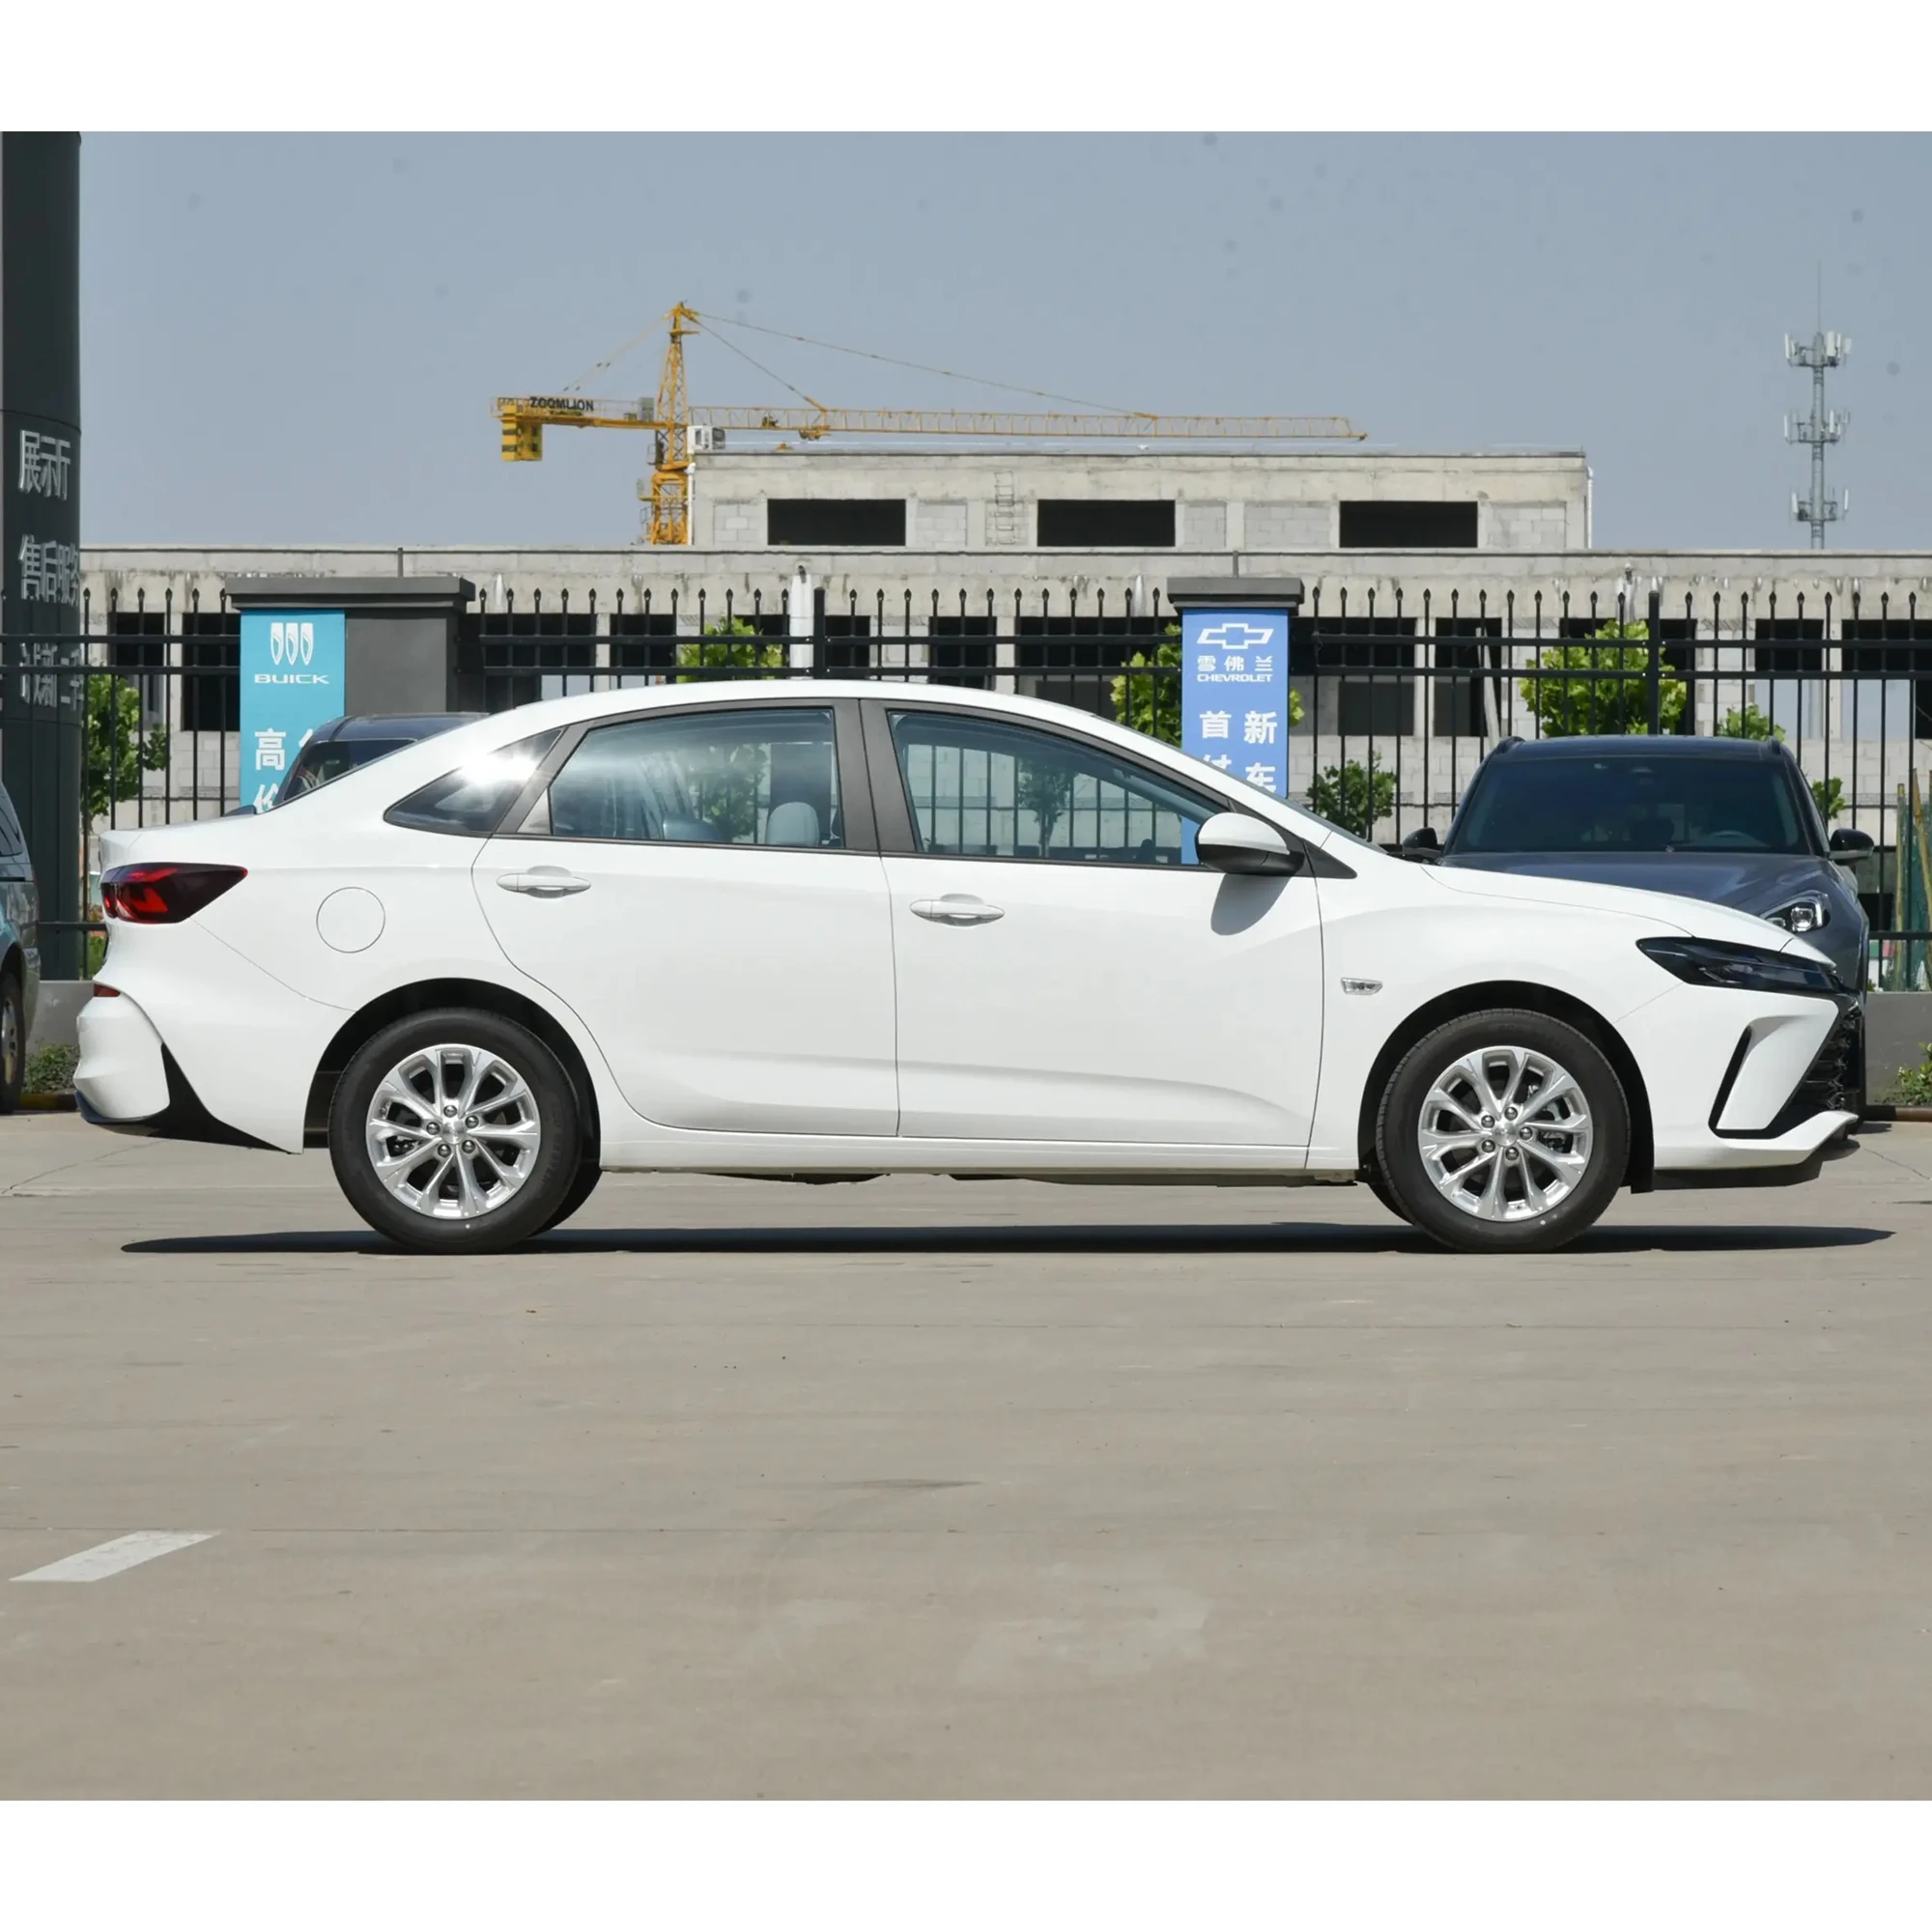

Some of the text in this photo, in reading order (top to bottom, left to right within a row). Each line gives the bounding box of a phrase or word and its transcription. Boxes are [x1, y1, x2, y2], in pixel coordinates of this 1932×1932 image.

[529, 396, 594, 412] ZOOMLION
[1197, 655, 1273, 672] 雪佛兰
[254, 674, 329, 684] BUICK
[1197, 673, 1273, 683] CHEVROLET
